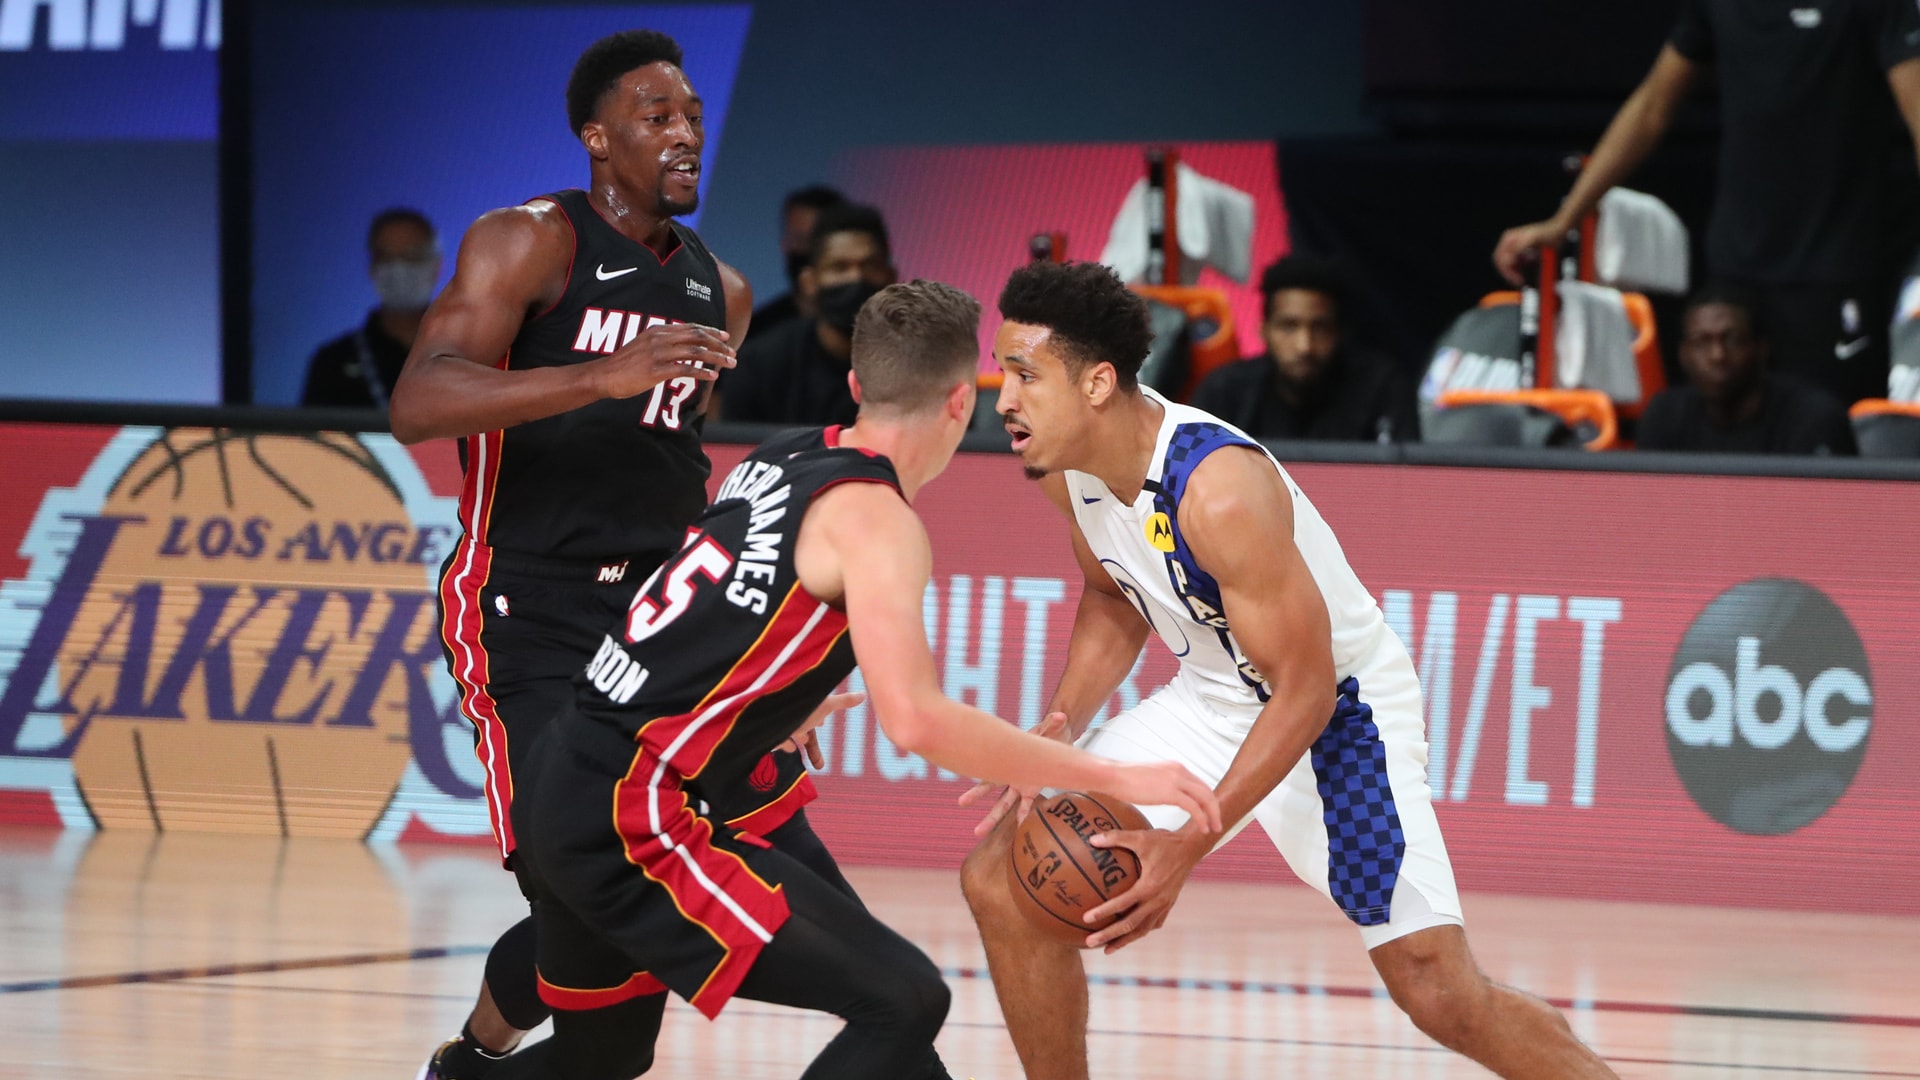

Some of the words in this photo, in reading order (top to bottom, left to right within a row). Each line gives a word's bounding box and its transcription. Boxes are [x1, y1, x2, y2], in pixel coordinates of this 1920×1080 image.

[685, 277, 711, 295] Ultimate
[640, 375, 699, 431] 13
[157, 515, 271, 558] LOS
[624, 524, 735, 645] 5
[0, 512, 486, 800] LAKER
[1665, 636, 1874, 752] abc
